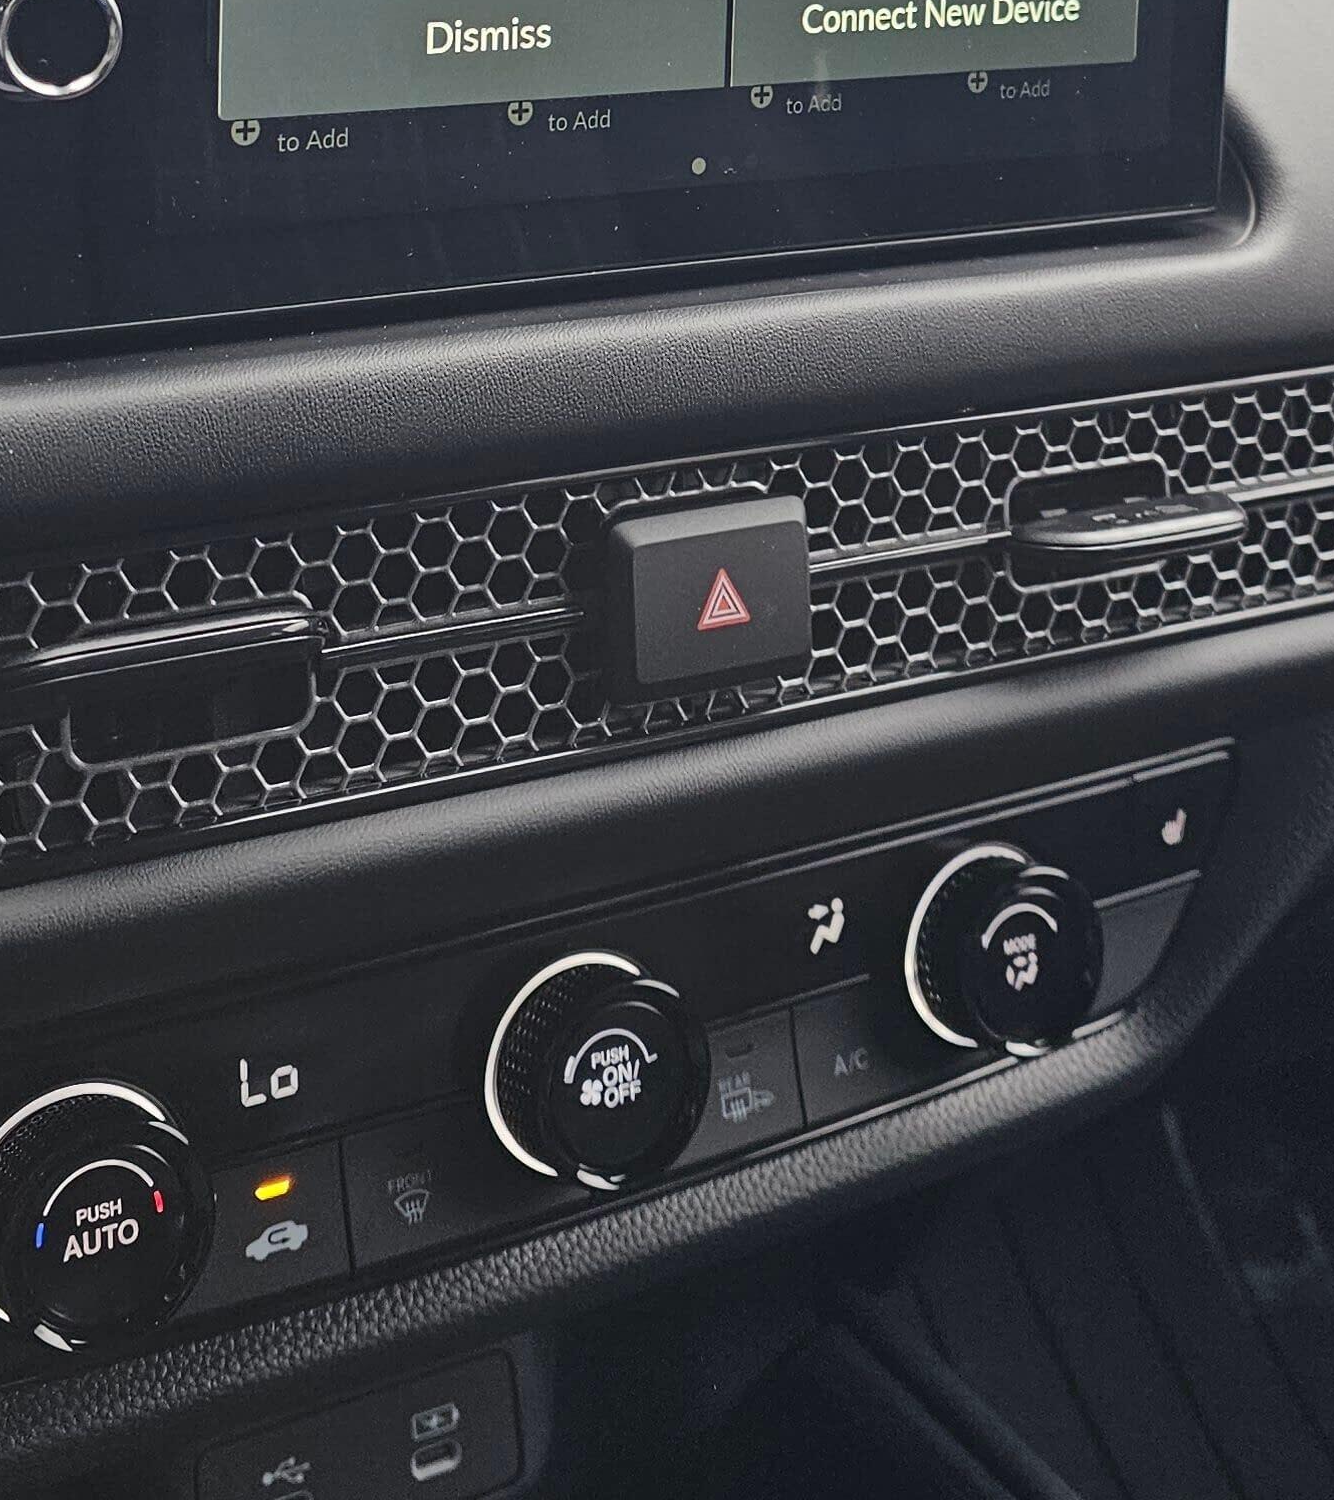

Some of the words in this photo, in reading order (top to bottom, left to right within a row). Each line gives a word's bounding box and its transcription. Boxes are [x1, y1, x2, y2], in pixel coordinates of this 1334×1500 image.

[802, 0, 918, 34] Connect
[426, 16, 552, 55] Dismiss
[999, 84, 1016, 99] to
[1019, 79, 1050, 98] Add
[786, 97, 804, 115] to
[807, 94, 842, 113] Add
[548, 113, 568, 132] to
[572, 108, 611, 131] Add
[277, 134, 300, 153] to
[306, 127, 349, 150] Add
[590, 1044, 630, 1070] PUSH
[602, 1058, 641, 1088] ON/
[604, 1079, 642, 1109] OFF
[75, 1197, 123, 1227] PUSH
[63, 1217, 140, 1263] AUTO
